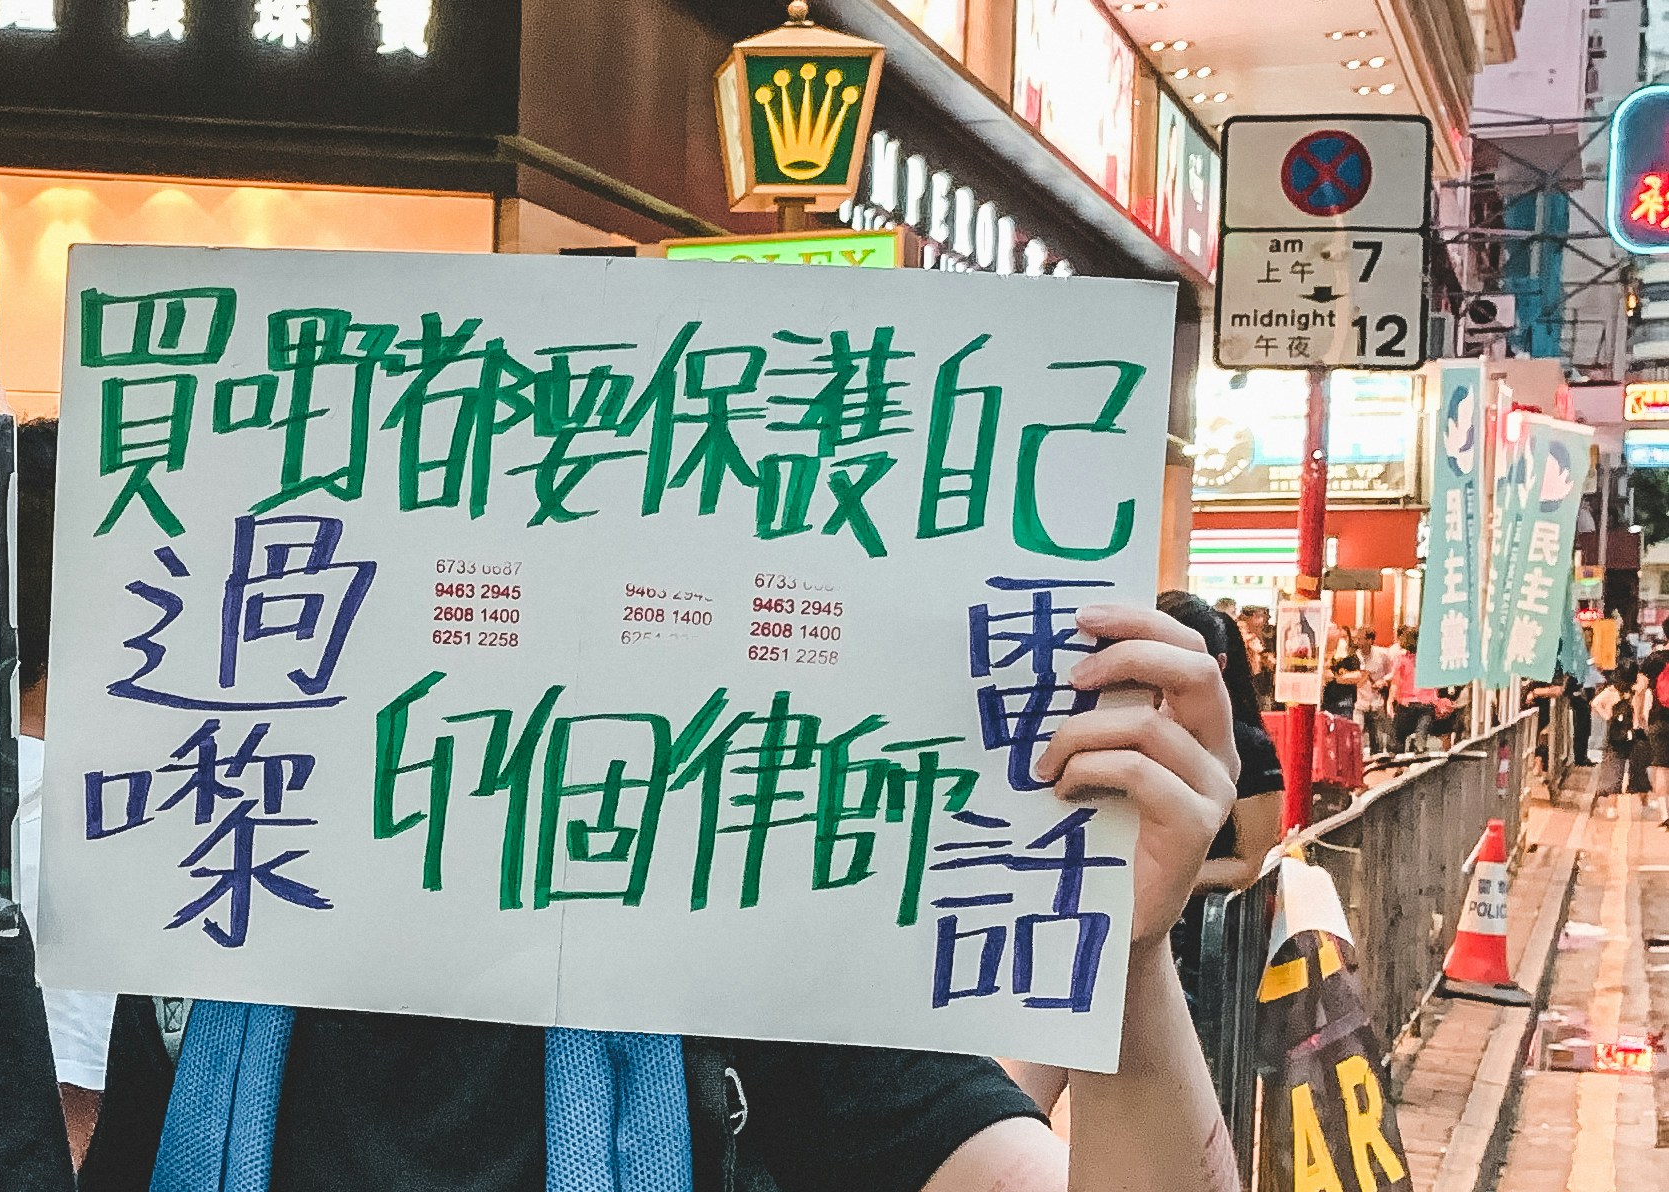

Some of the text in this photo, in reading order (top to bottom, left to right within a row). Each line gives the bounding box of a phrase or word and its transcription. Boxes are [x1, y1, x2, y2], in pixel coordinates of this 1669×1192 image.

[1268, 238, 1304, 253] am
[1257, 260, 1315, 284] 上午
[1352, 240, 1383, 283] 7
[1231, 308, 1336, 332] midnight
[1351, 313, 1409, 358] 12
[1254, 334, 1313, 359] 午夜
[80, 286, 1147, 562] 買嘢都要保護自己
[436, 559, 476, 574] 6733
[434, 582, 521, 600] 9463 2945
[754, 572, 797, 590] 6733
[433, 606, 520, 625] 2608 1400
[622, 605, 713, 626] 2608 1400
[752, 597, 843, 618] 9463 2945
[431, 629, 519, 648] 6251 2258
[749, 621, 842, 642] 2608 1400
[747, 645, 840, 666] 6251 2258
[84, 514, 378, 948] 過嚟
[372, 670, 981, 928] 印個律師
[928, 575, 1128, 1014] 電話
